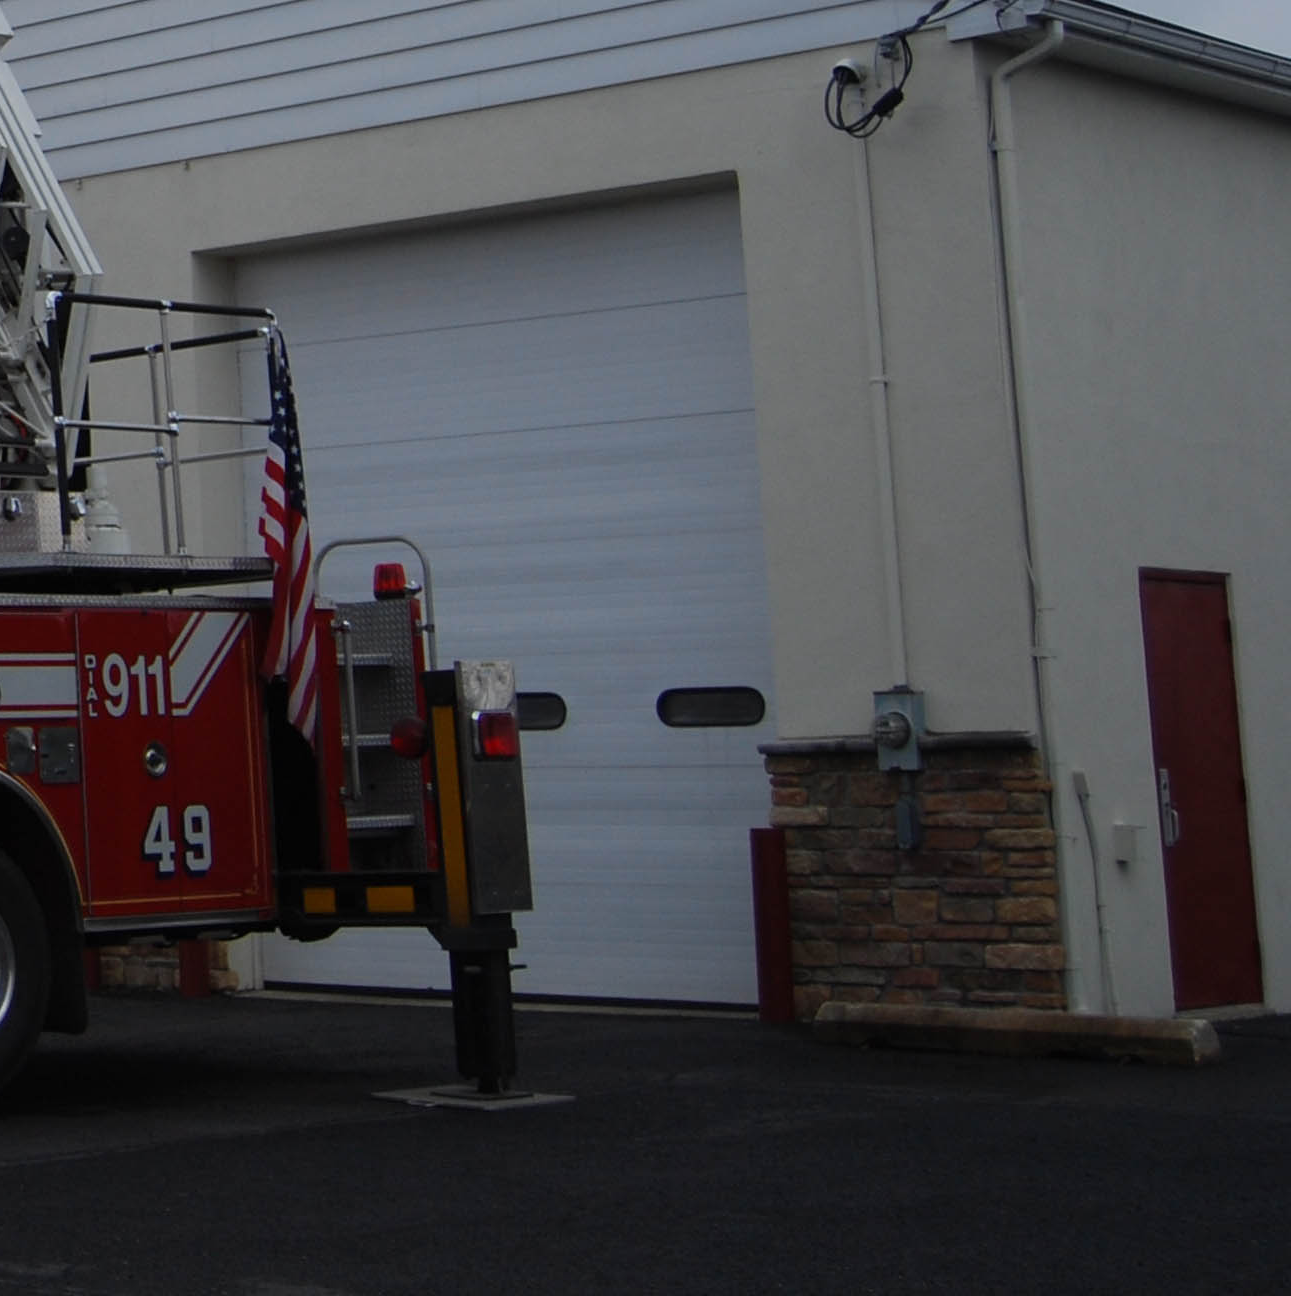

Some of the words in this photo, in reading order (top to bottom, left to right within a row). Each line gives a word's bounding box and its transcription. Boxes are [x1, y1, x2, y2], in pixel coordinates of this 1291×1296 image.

[83, 653, 99, 718] DIAL
[101, 652, 167, 718] 911
[143, 803, 213, 876] 49
